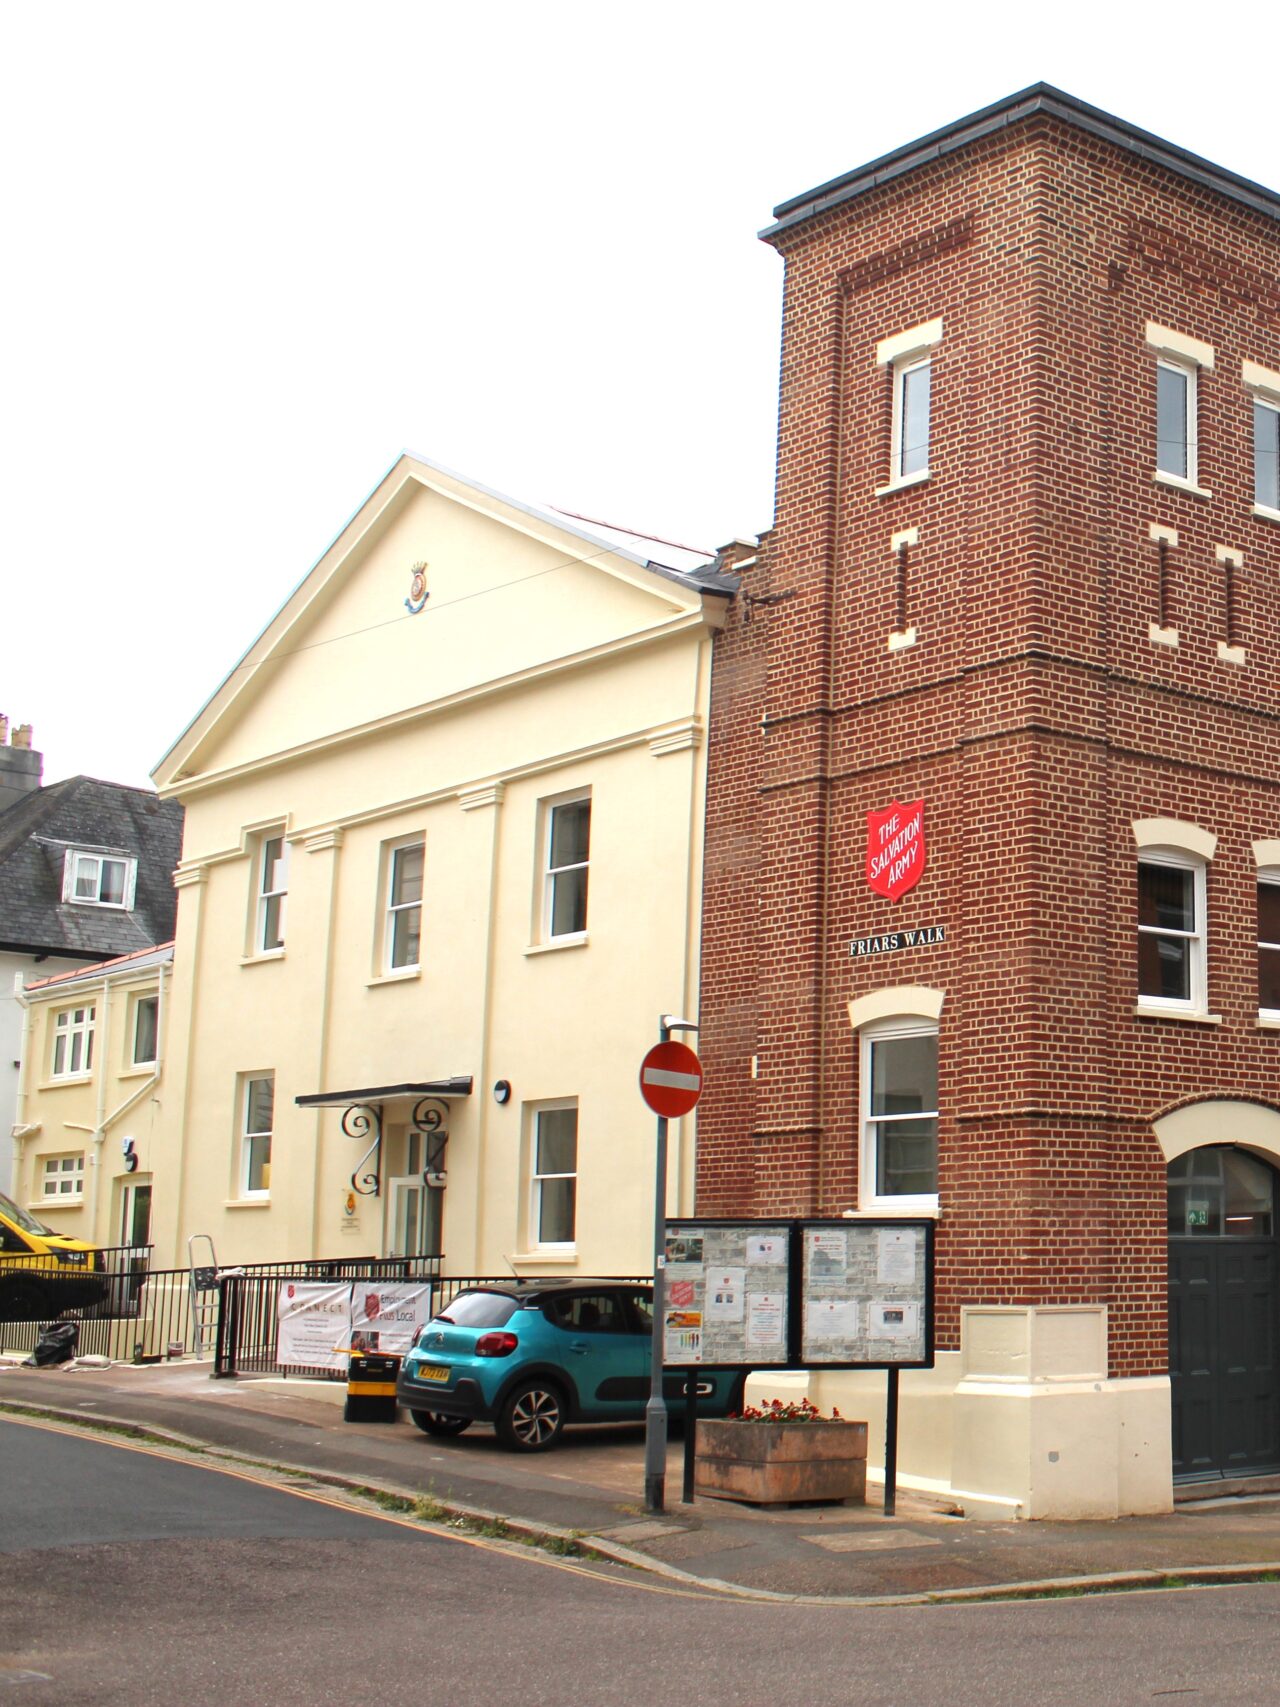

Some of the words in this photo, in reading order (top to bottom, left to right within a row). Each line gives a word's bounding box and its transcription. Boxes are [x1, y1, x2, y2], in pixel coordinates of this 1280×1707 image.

[879, 813, 900, 844] THE
[870, 812, 920, 879] SALVATION
[887, 841, 918, 889] ARMY
[850, 934, 899, 956] FRIARS
[904, 927, 944, 946] WALK
[396, 1309, 416, 1321] Local
